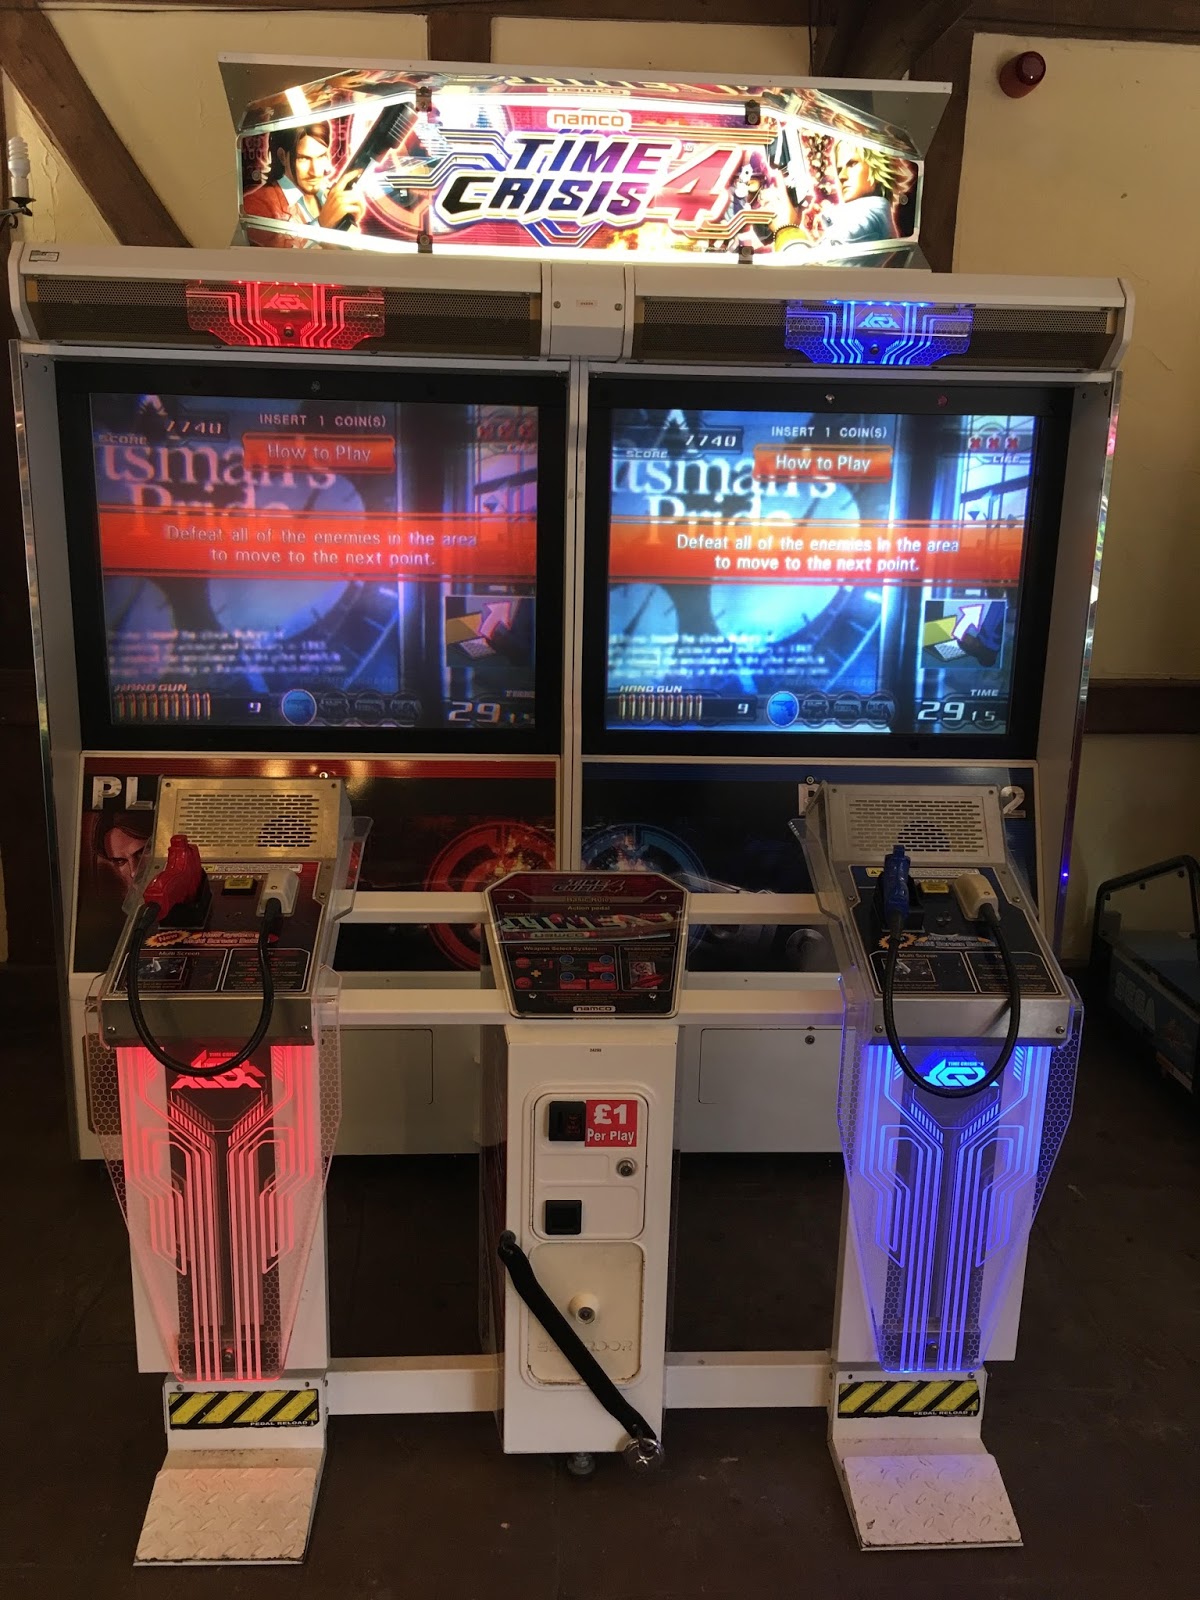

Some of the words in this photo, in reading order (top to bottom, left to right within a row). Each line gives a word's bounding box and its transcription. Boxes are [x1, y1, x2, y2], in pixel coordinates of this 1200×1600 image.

[553, 112, 624, 127] namco
[513, 138, 673, 174] TIME
[442, 176, 649, 217] CRISIS
[648, 148, 734, 222] 4
[259, 414, 307, 426] INSERT
[319, 415, 325, 427] 1
[334, 415, 387, 428] COIN(S)
[771, 426, 815, 437] INSERT
[825, 427, 830, 438] 1
[839, 426, 888, 438] COIN(S)
[268, 443, 307, 459] How
[313, 445, 330, 460] to
[336, 445, 371, 462] Play
[775, 454, 811, 470] How
[817, 456, 832, 470] to
[838, 454, 872, 475] Play
[166, 525, 223, 541] Defeat
[232, 527, 248, 542] all
[256, 528, 272, 542] of
[281, 528, 306, 543] the
[313, 532, 381, 545] enemies
[388, 531, 400, 545] in
[408, 530, 435, 545] the
[442, 534, 477, 547] area
[677, 533, 728, 549] Defeat
[735, 535, 752, 550] all
[757, 535, 774, 550] of
[780, 536, 804, 551] the
[810, 538, 872, 552] enemies
[877, 536, 892, 552] in
[896, 536, 922, 552] the
[926, 539, 960, 553] area
[211, 549, 228, 561] to
[235, 550, 281, 563] move
[288, 550, 305, 563] to
[313, 550, 338, 564] the
[345, 551, 382, 564] next
[389, 551, 435, 567] point.
[714, 555, 731, 569] to
[736, 556, 779, 570] move
[785, 556, 801, 570] to
[806, 556, 832, 571] the
[836, 557, 872, 571] next
[877, 556, 919, 573] point.
[158, 684, 188, 692] GUN
[619, 685, 654, 693] HAND
[656, 684, 683, 693] GUN
[970, 689, 999, 697] TIME
[448, 701, 501, 723] 29
[917, 701, 965, 721] 29
[92, 776, 157, 810] PL
[1001, 785, 1026, 818] 2
[158, 932, 178, 942] New
[1114, 971, 1156, 1031] SEGA
[593, 1103, 628, 1125] £1
[587, 1127, 606, 1143] Per
[610, 1130, 635, 1145] Play
